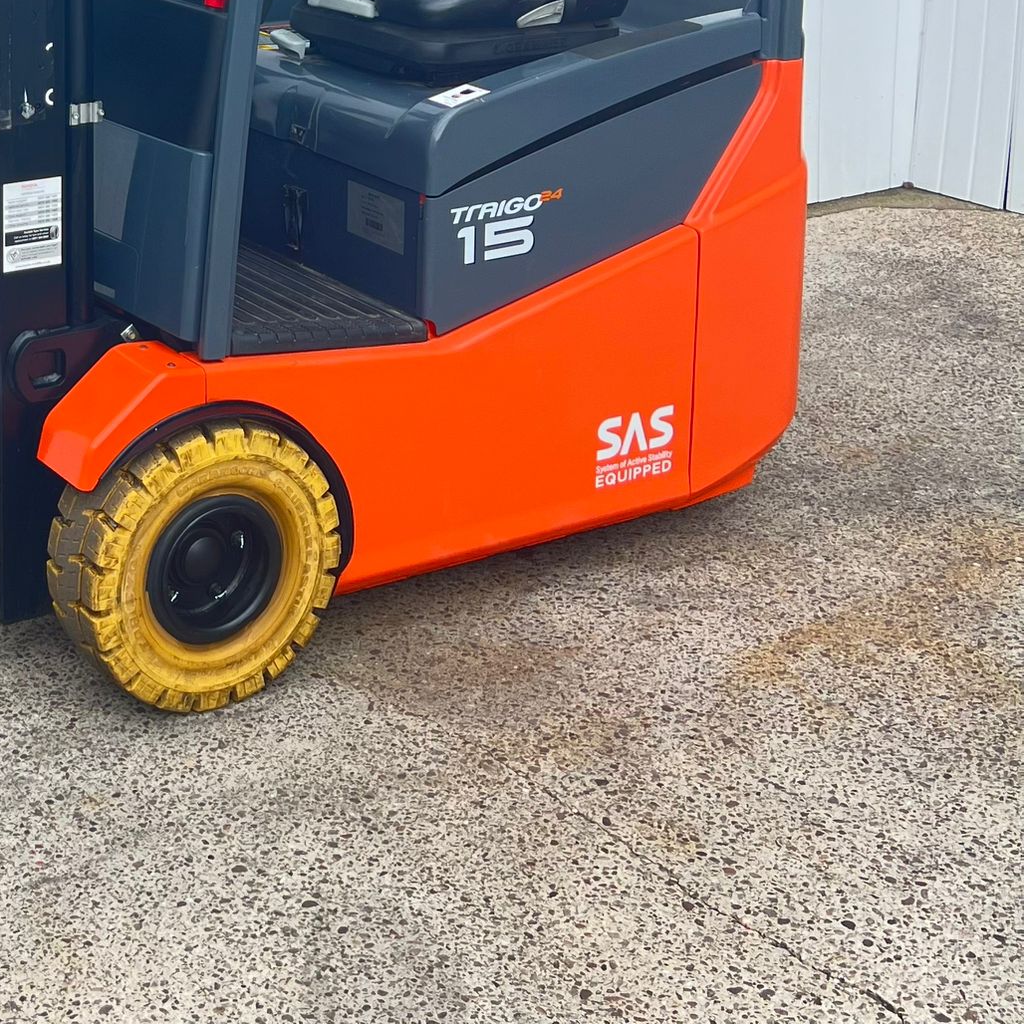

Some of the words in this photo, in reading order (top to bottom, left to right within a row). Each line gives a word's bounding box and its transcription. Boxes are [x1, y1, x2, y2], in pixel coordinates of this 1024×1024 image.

[457, 215, 535, 265] 15
[596, 404, 675, 462] SAS
[595, 459, 672, 488] EQUIPPED
